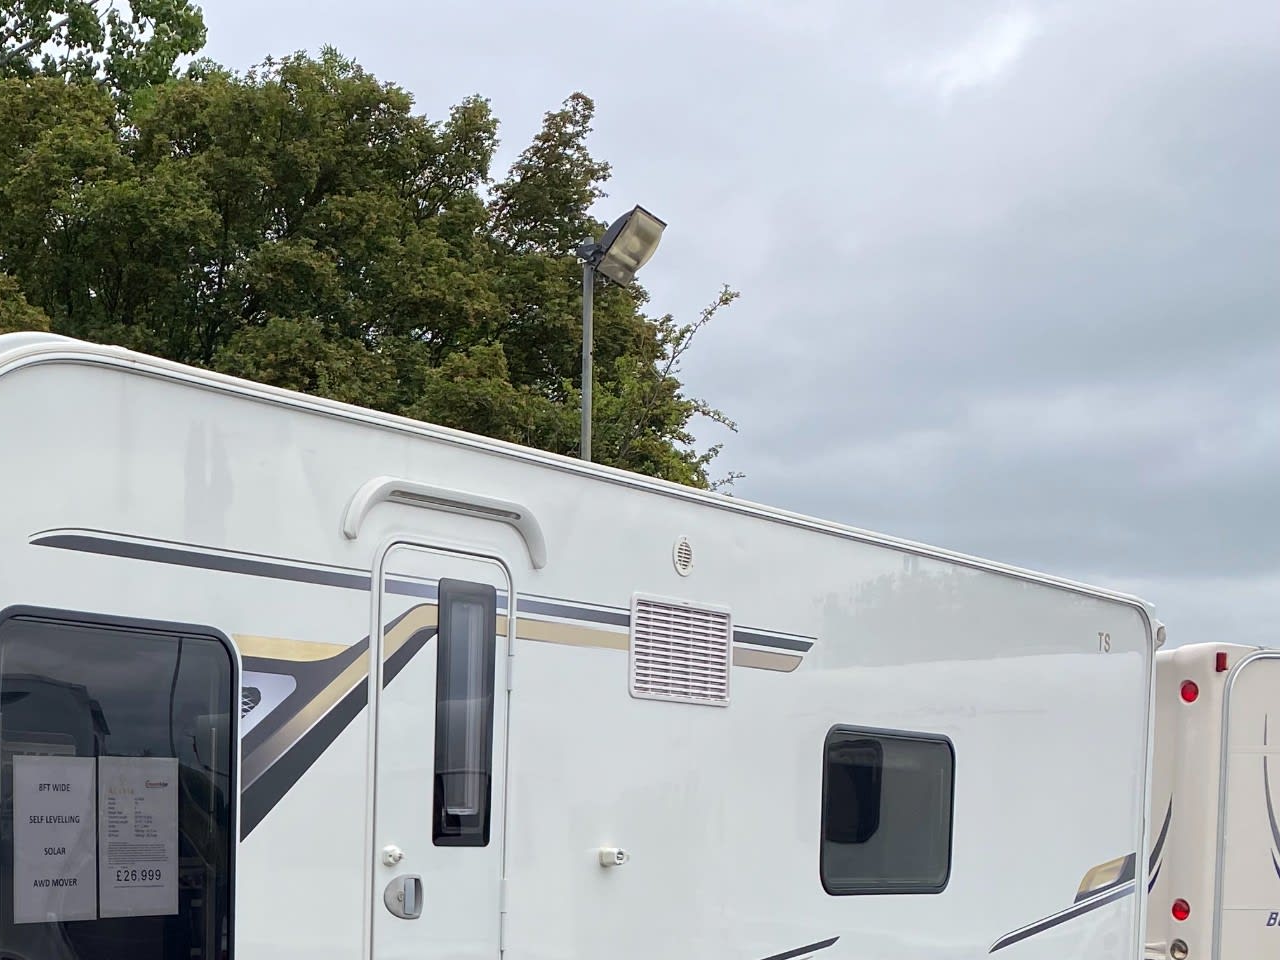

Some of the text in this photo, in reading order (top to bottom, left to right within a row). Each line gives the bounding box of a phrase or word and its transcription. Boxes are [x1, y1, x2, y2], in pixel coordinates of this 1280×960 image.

[1097, 632, 1111, 653] TS
[52, 783, 71, 792] WIDE
[29, 815, 80, 824] SELF LEVELLING
[44, 847, 66, 856] SOLAR
[33, 878, 78, 888] AWD MOVER
